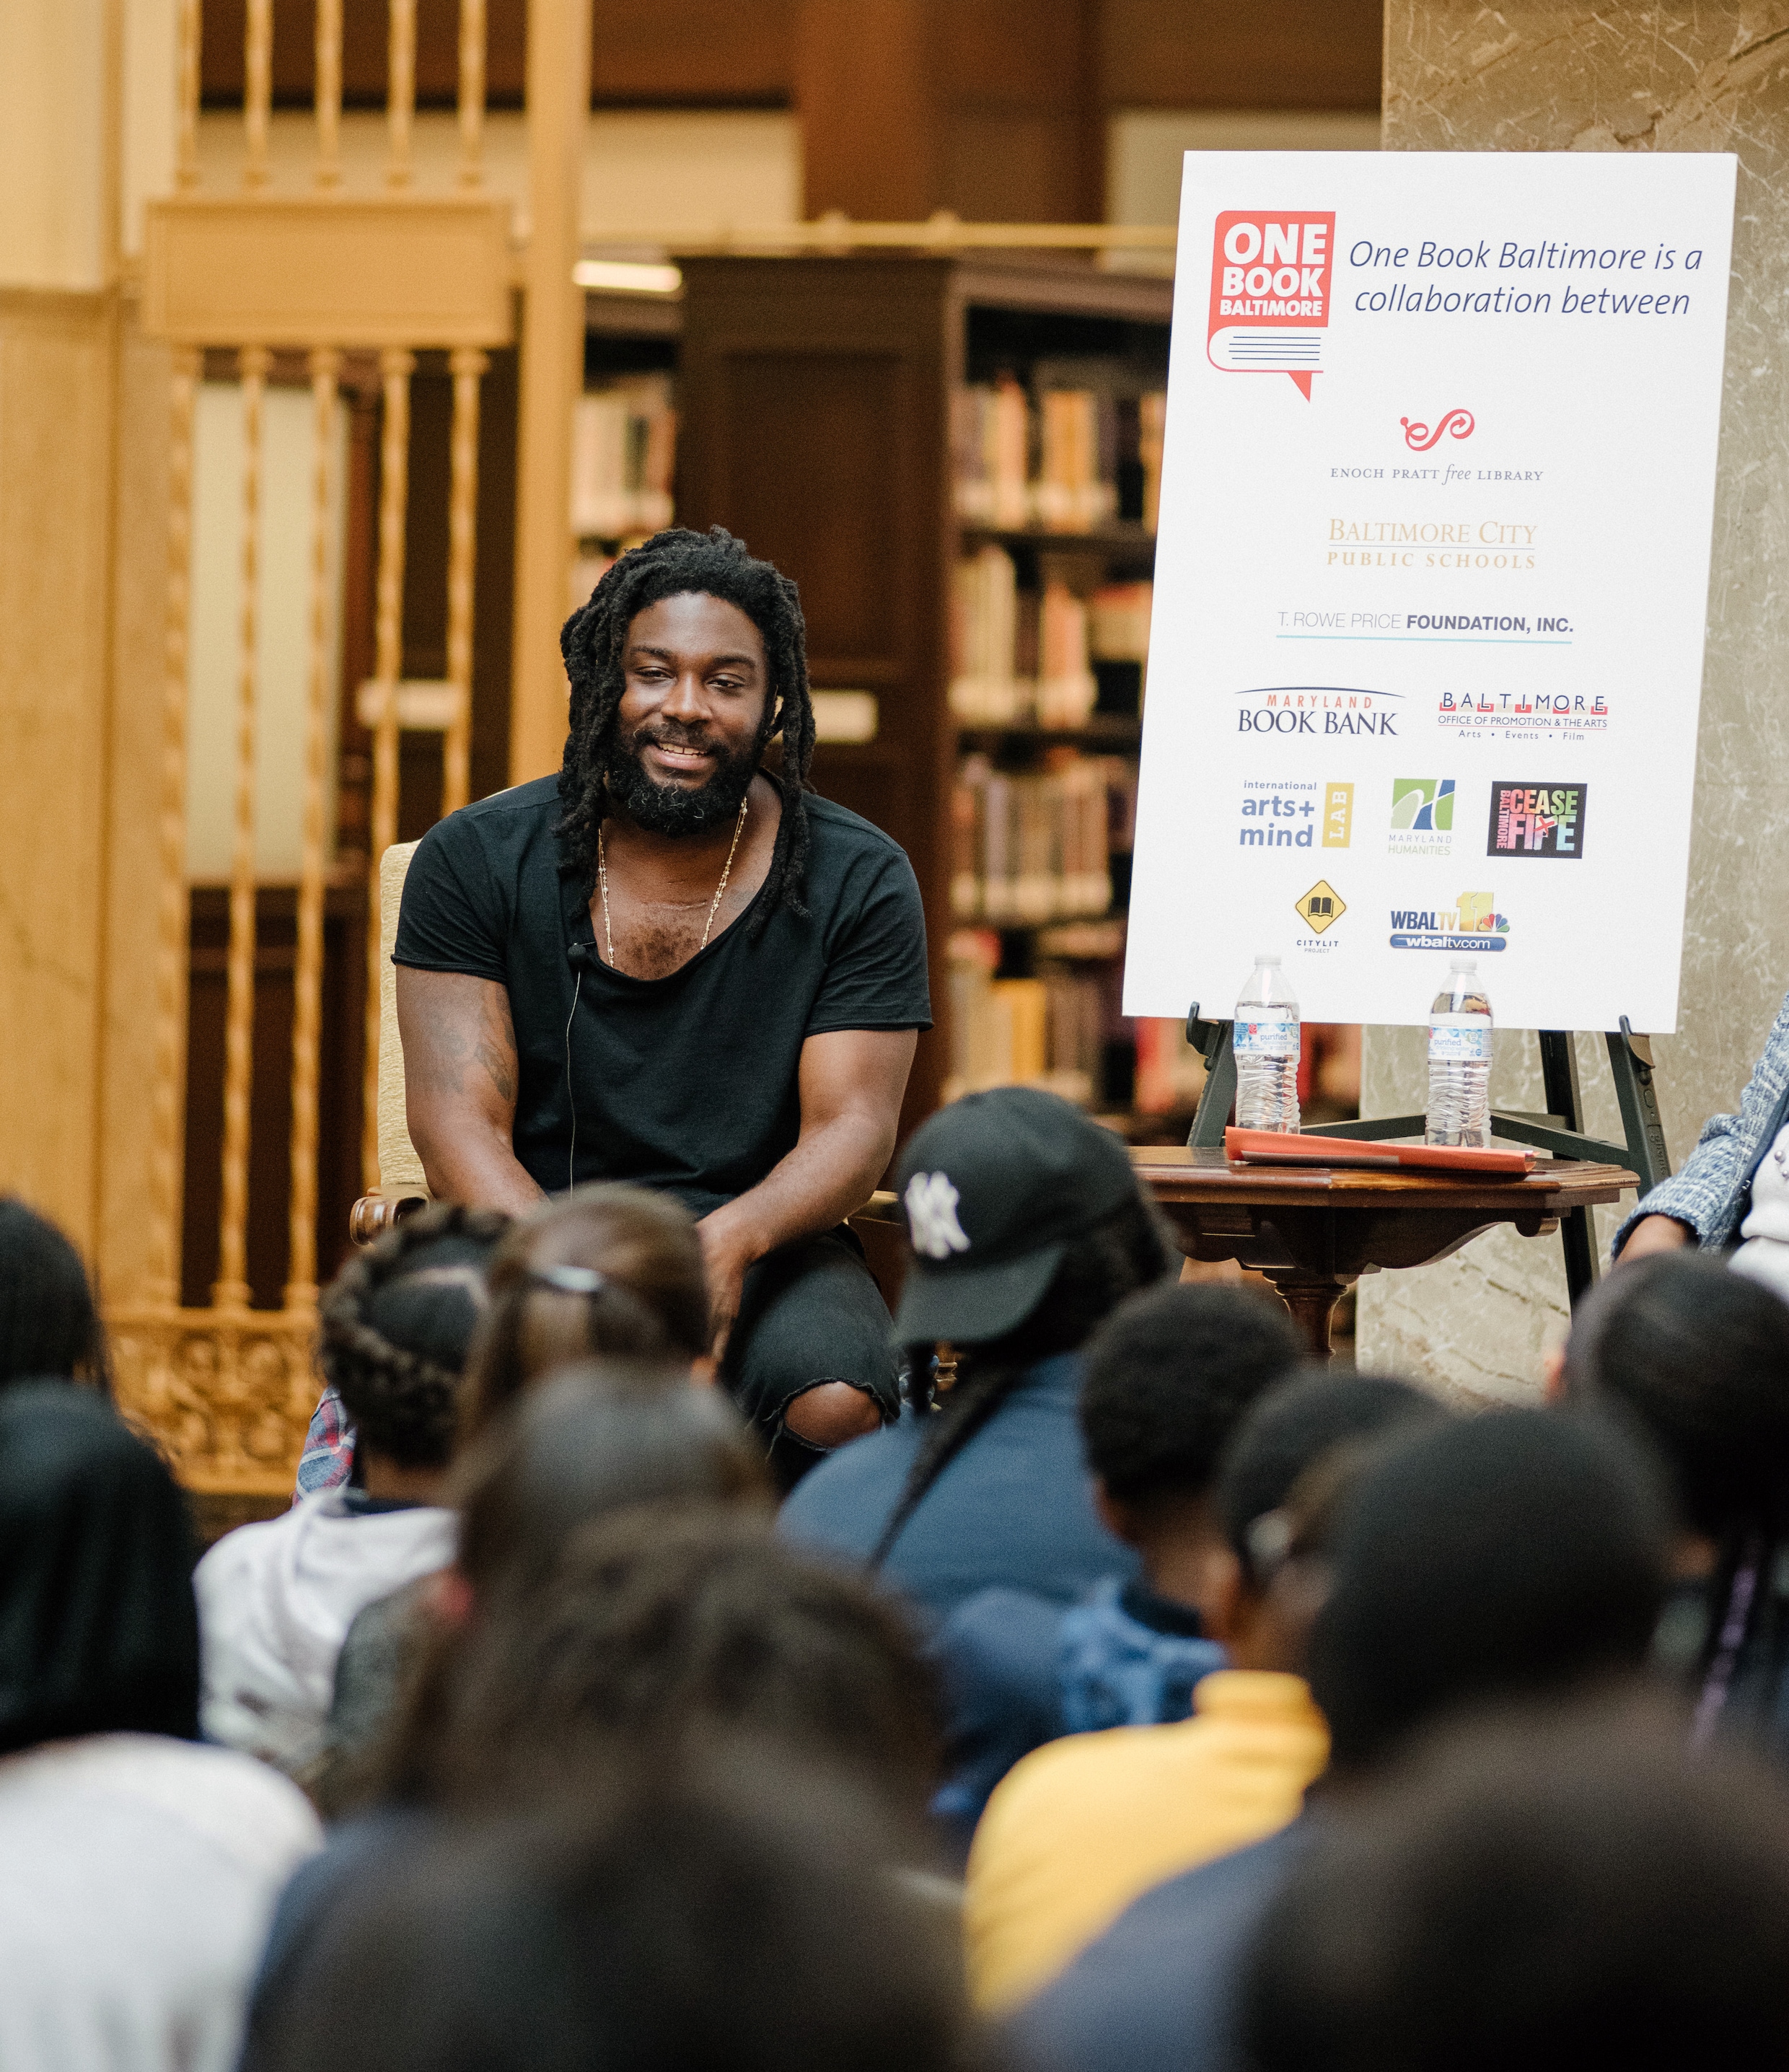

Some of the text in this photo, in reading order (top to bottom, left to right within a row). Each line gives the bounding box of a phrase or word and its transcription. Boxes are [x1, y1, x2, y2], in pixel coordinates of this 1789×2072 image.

[1224, 222, 1327, 265] ONE
[1350, 240, 1702, 270] One Book Baltimore is a
[1222, 267, 1324, 297] BOOK
[1220, 299, 1322, 316] BALTIMORE
[1355, 284, 1689, 314] collaboration between
[1331, 464, 1543, 486] ENOCH PRATT free LIBRARY
[1328, 552, 1534, 569] PUBLIC SCHOOLS
[1278, 612, 1573, 633] T. ROWE PRICE FOUNDATION, INC.
[1267, 694, 1372, 708] MARYLAND
[1443, 693, 1604, 711] BALTIMORE
[1239, 710, 1397, 735] BOOK BANK
[1438, 716, 1471, 724] OFFICE
[1476, 716, 1489, 725] OF
[1491, 717, 1551, 726] PROMOTION
[1563, 719, 1581, 727] THE
[1506, 730, 1538, 739] Events
[1244, 781, 1317, 790] international
[1510, 789, 1578, 815] CEASE
[1329, 791, 1347, 839] LAB
[1496, 790, 1511, 849] BALTIMORE
[1240, 822, 1313, 847] mind
[1389, 835, 1451, 843] MARYLAND
[1388, 845, 1451, 856] HUMANITIES
[1405, 936, 1490, 949] wbaltv.com
[1260, 1033, 1287, 1042] purified
